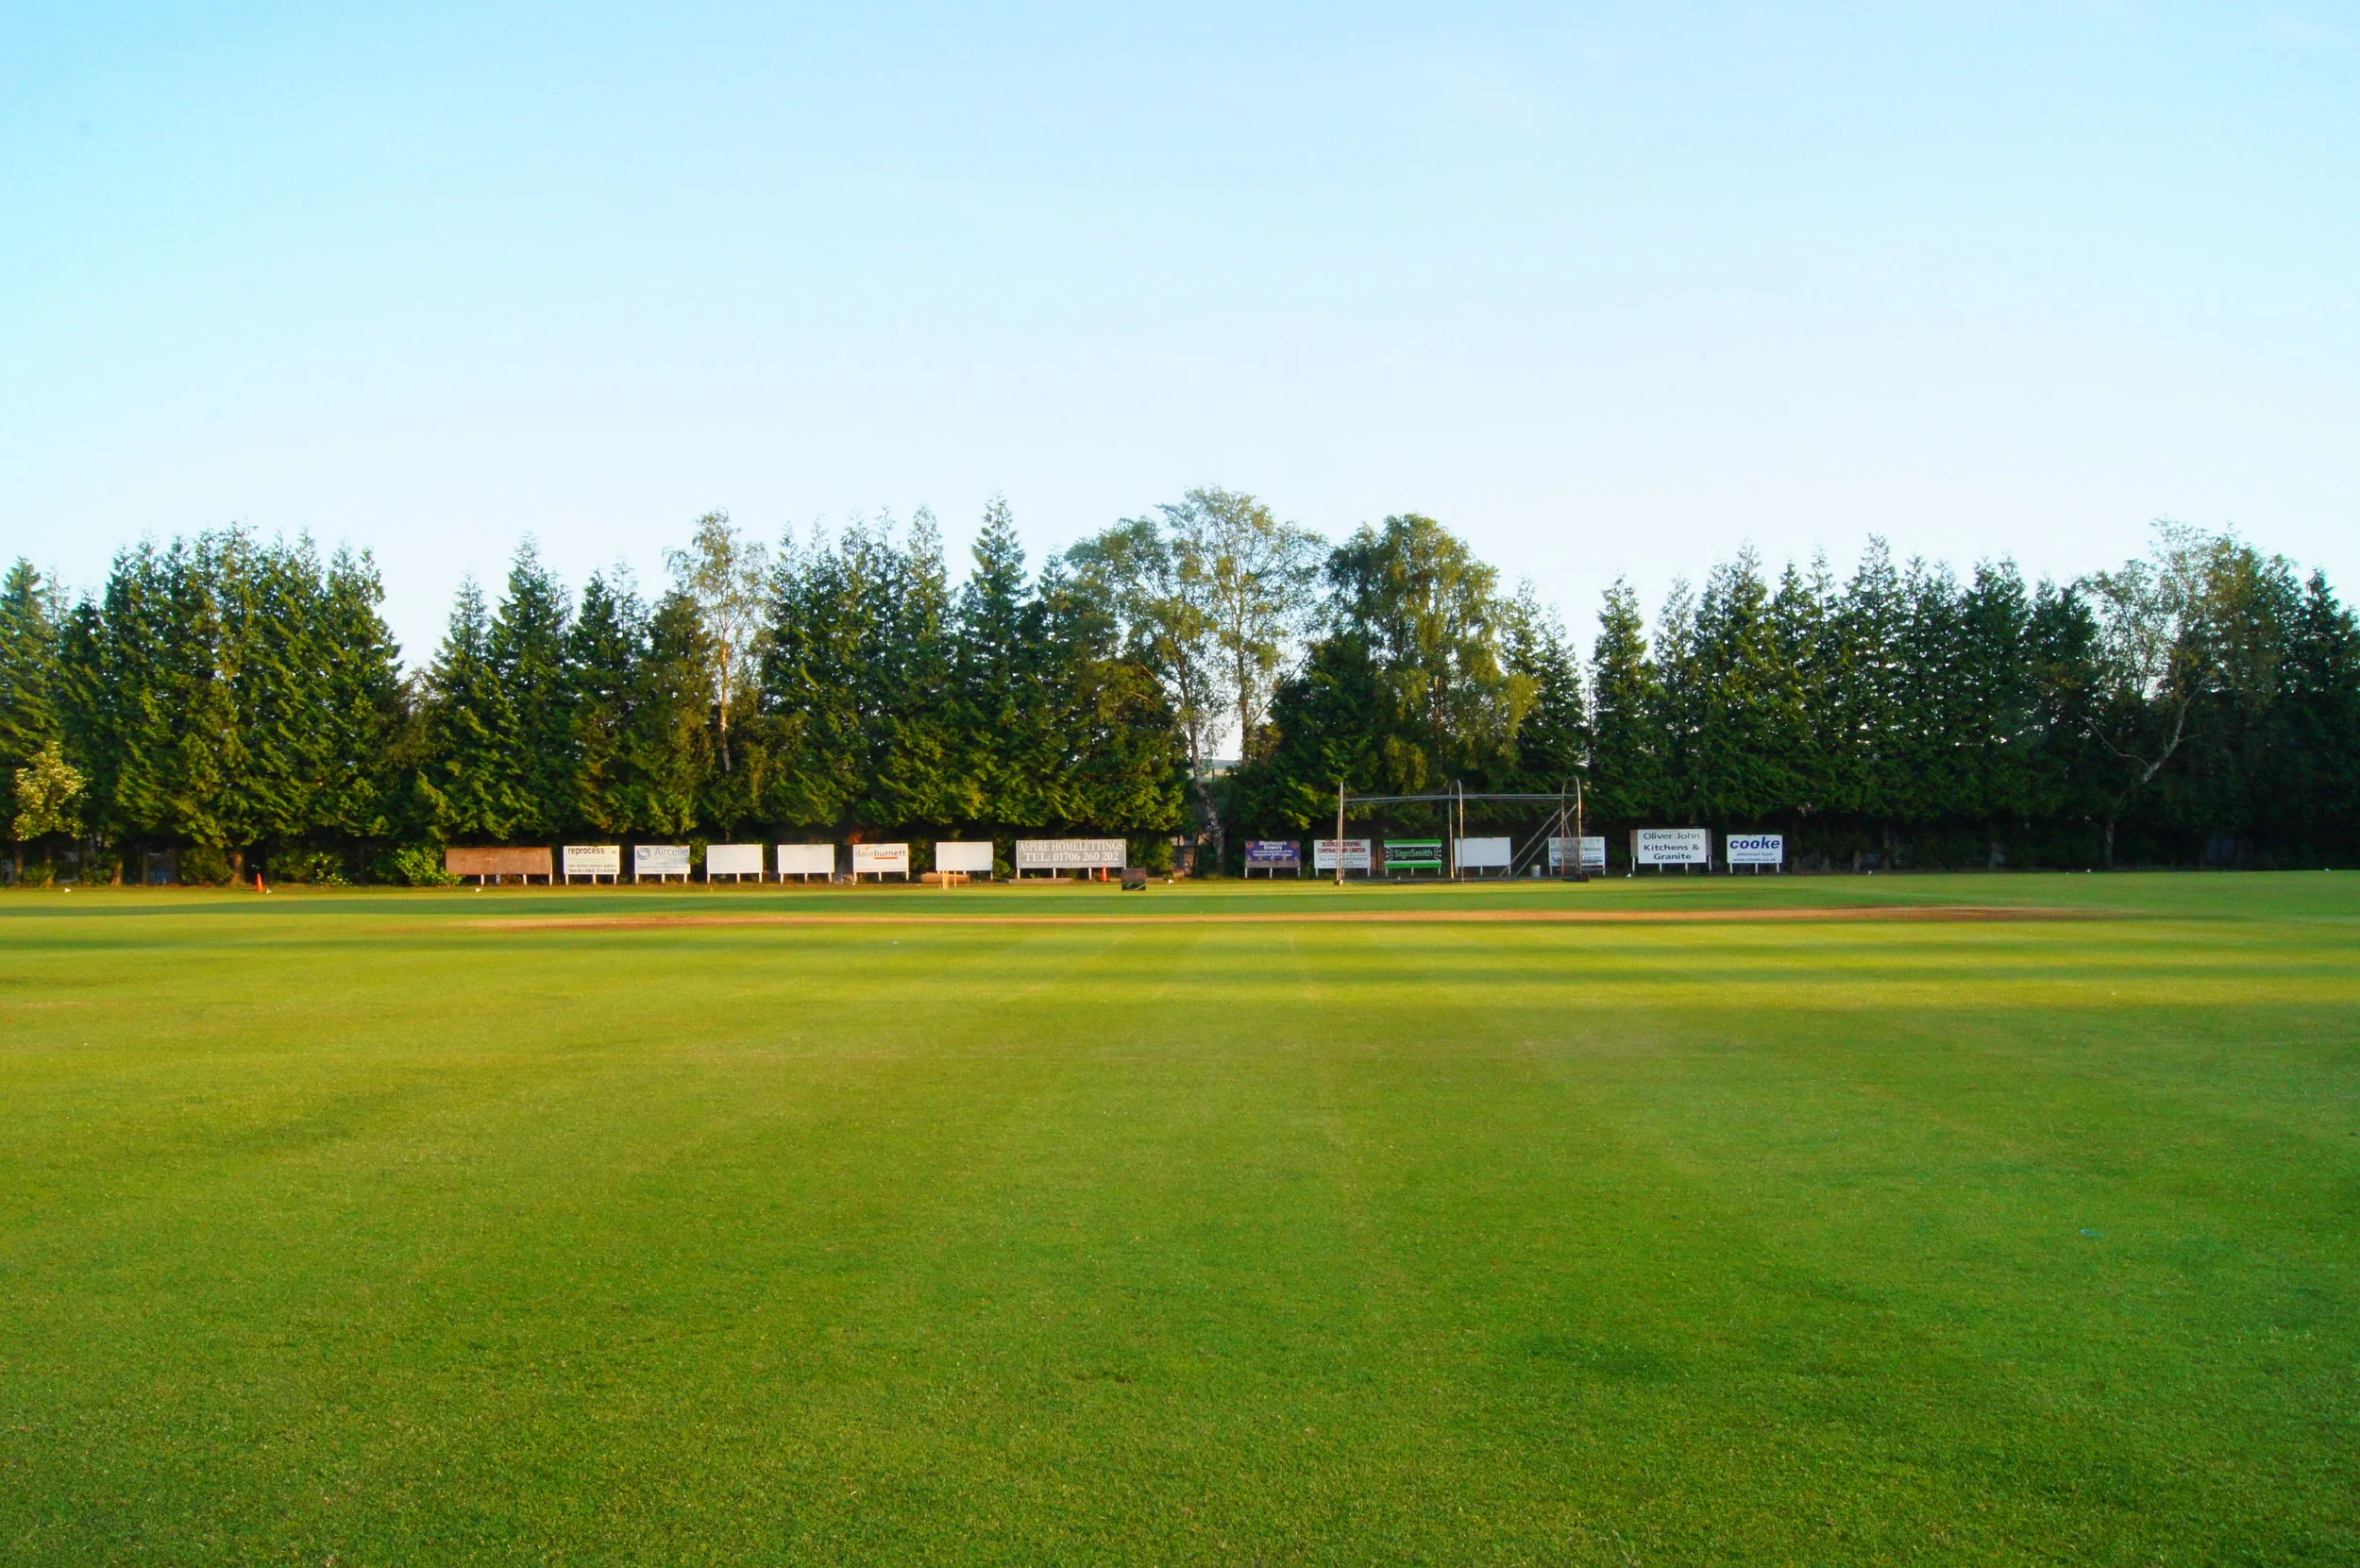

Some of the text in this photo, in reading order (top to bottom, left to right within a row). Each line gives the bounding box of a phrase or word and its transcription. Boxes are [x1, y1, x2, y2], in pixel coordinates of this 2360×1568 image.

[1020, 841, 1050, 851] ASPIRE
[1729, 836, 1780, 849] cooke
[567, 848, 605, 856] reprocess
[1023, 851, 1119, 862] TEL: 01706 260 202
